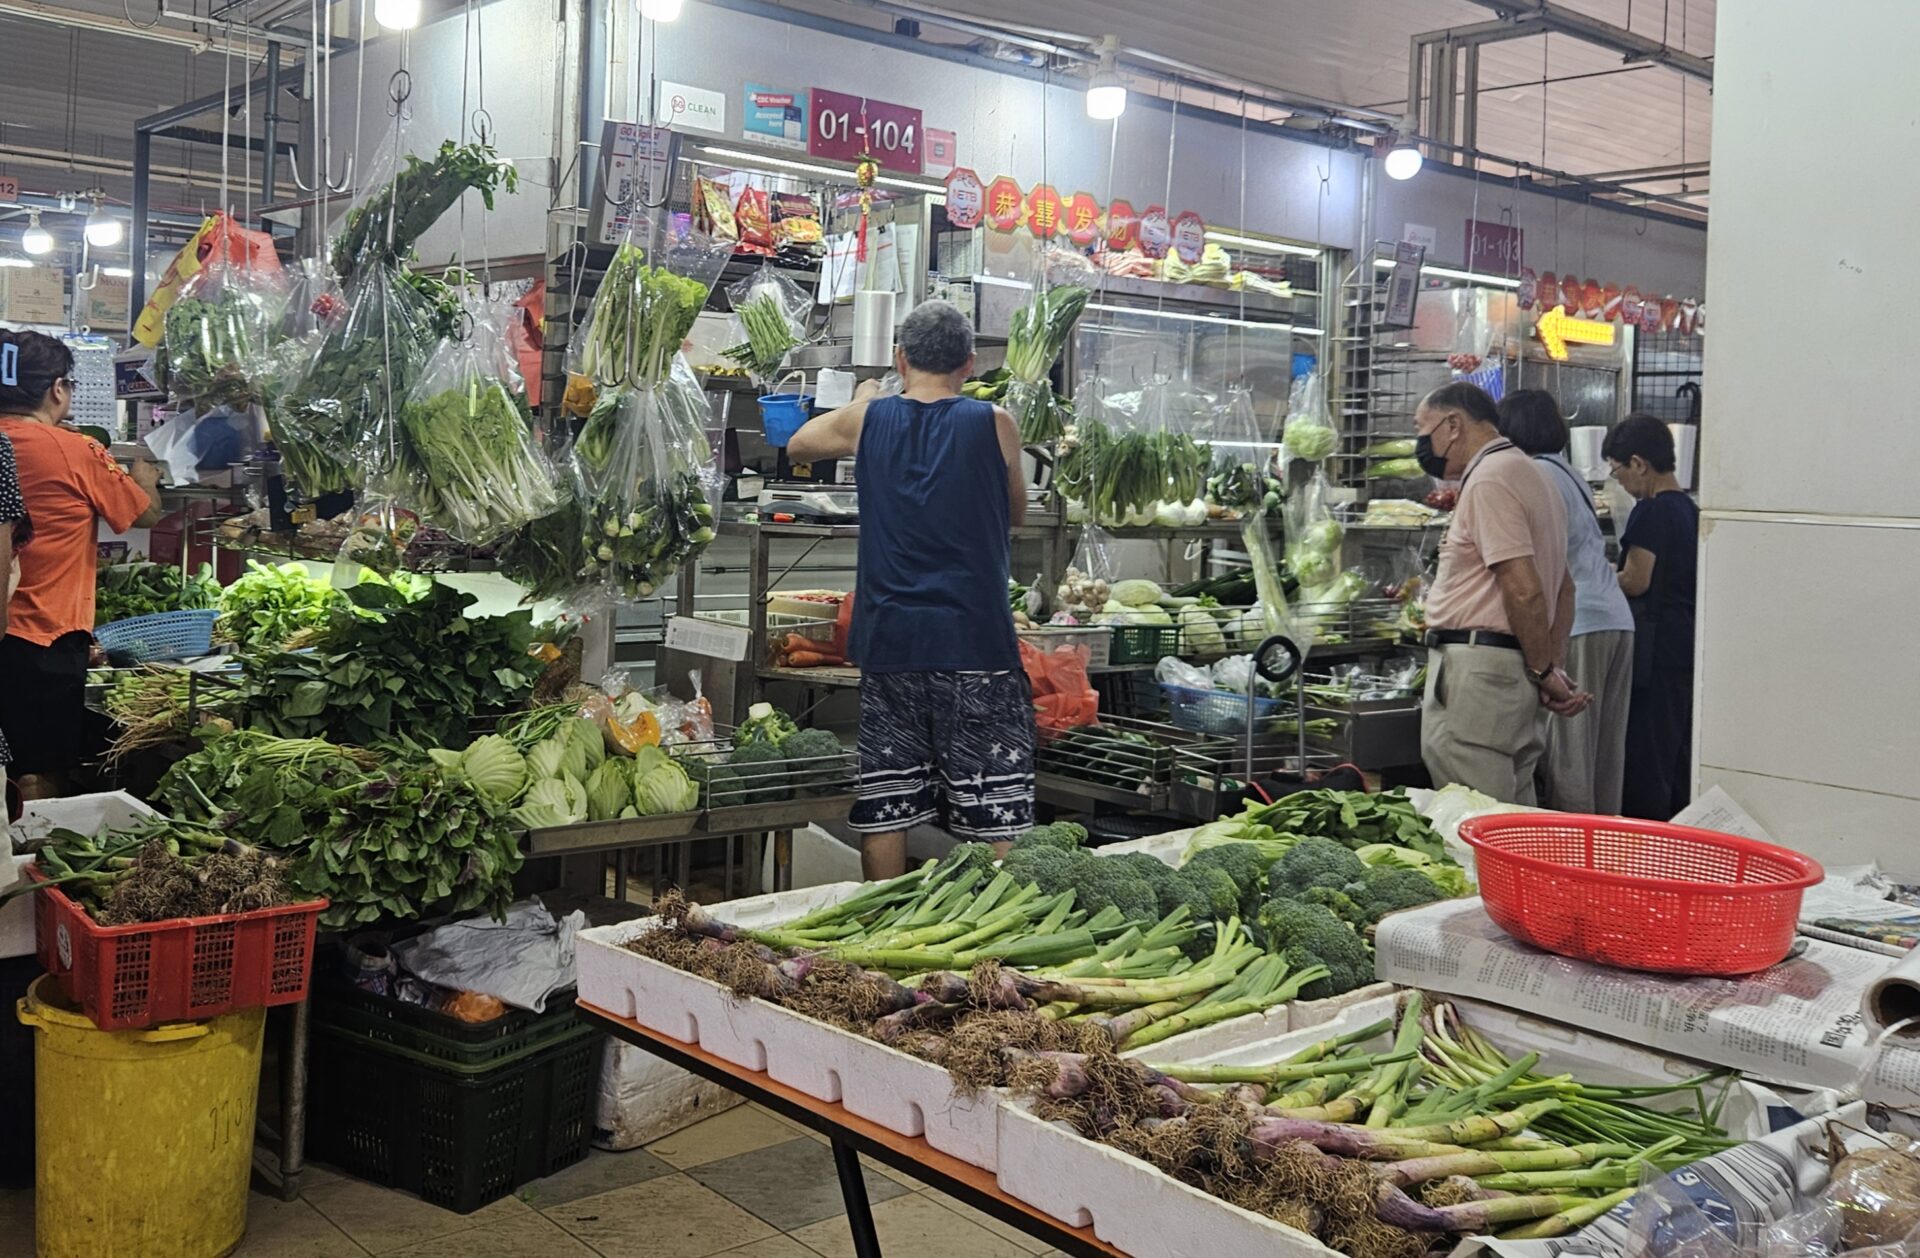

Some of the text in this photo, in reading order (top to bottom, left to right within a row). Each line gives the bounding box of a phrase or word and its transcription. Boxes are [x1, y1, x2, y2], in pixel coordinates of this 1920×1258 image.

[687, 102, 716, 116] CLEAN
[819, 109, 915, 154] 01-104
[1473, 233, 1520, 261] 01-103
